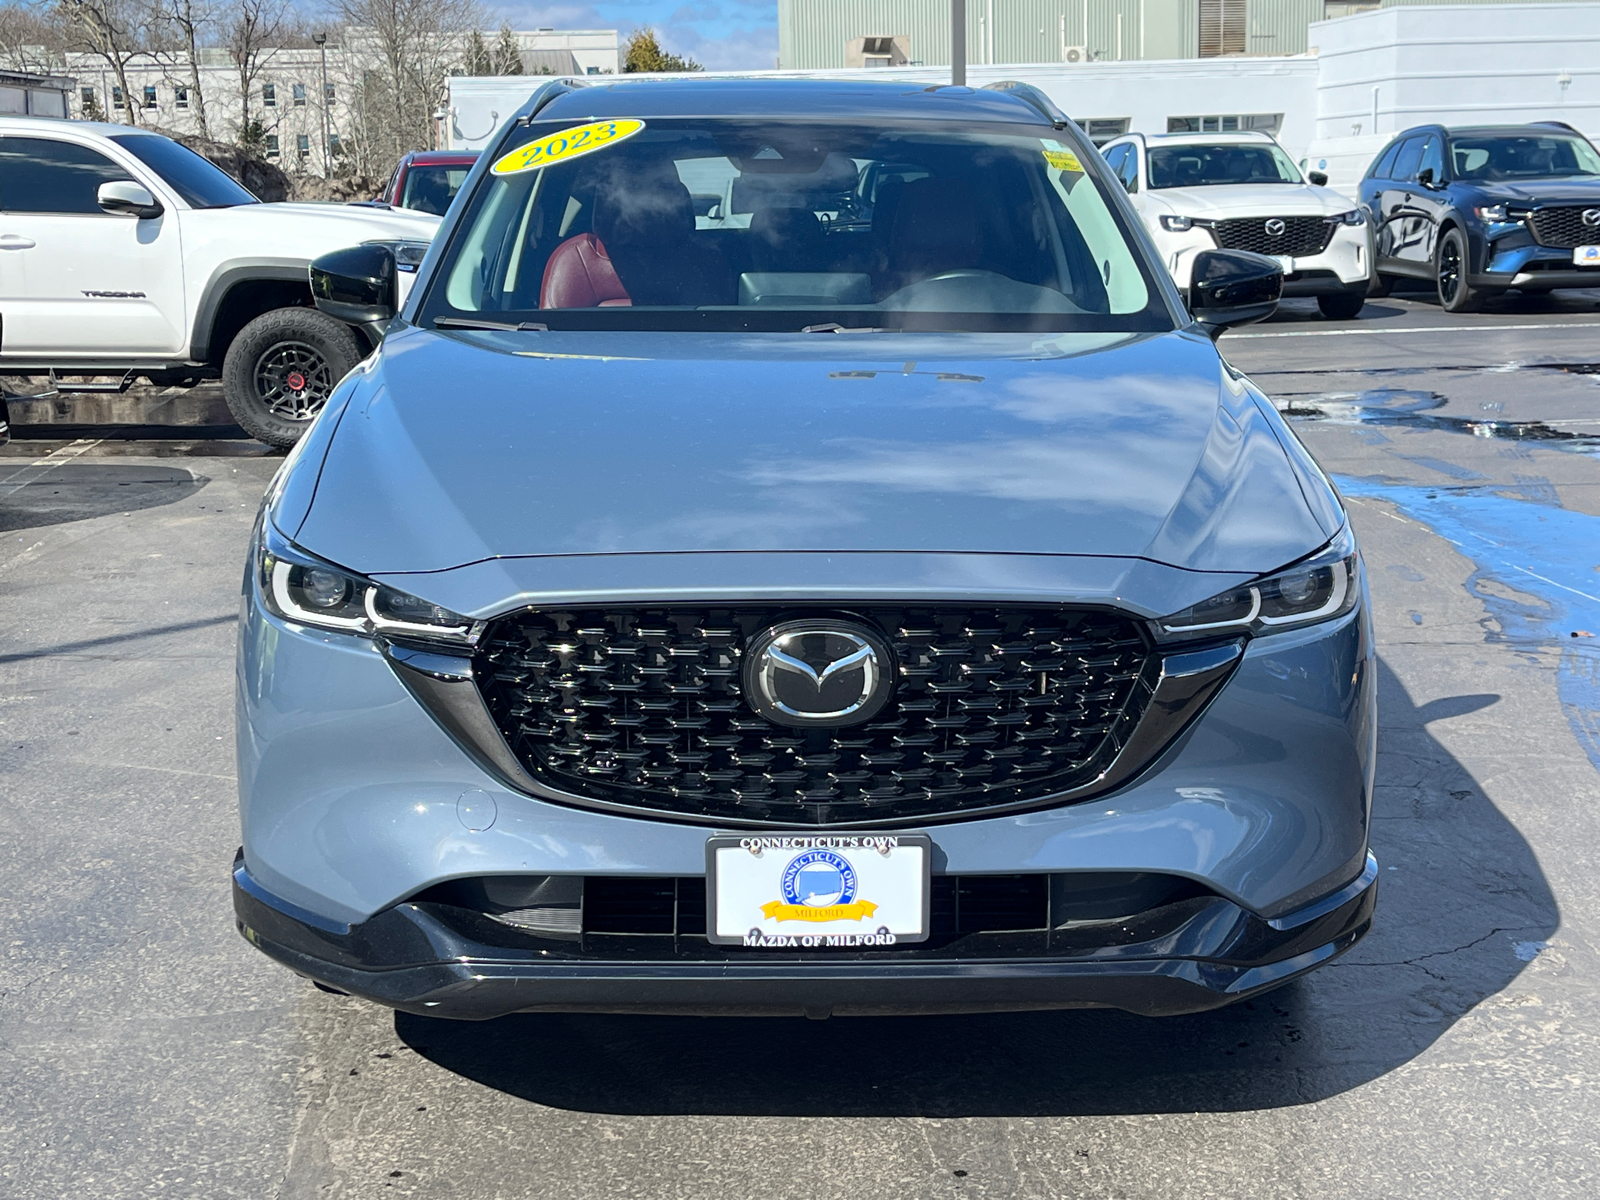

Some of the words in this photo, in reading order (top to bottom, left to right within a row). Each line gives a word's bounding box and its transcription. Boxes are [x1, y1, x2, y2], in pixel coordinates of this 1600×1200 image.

[521, 123, 617, 167] 2023
[80, 289, 147, 298] TACOMA
[739, 837, 859, 848] CONNECTICUT'S
[862, 836, 899, 848] OWN
[843, 870, 854, 898] OWN
[794, 908, 844, 918] MILFORD
[743, 935, 798, 947] MAZDA
[801, 935, 823, 947] OF
[826, 933, 897, 947] MILFORD
